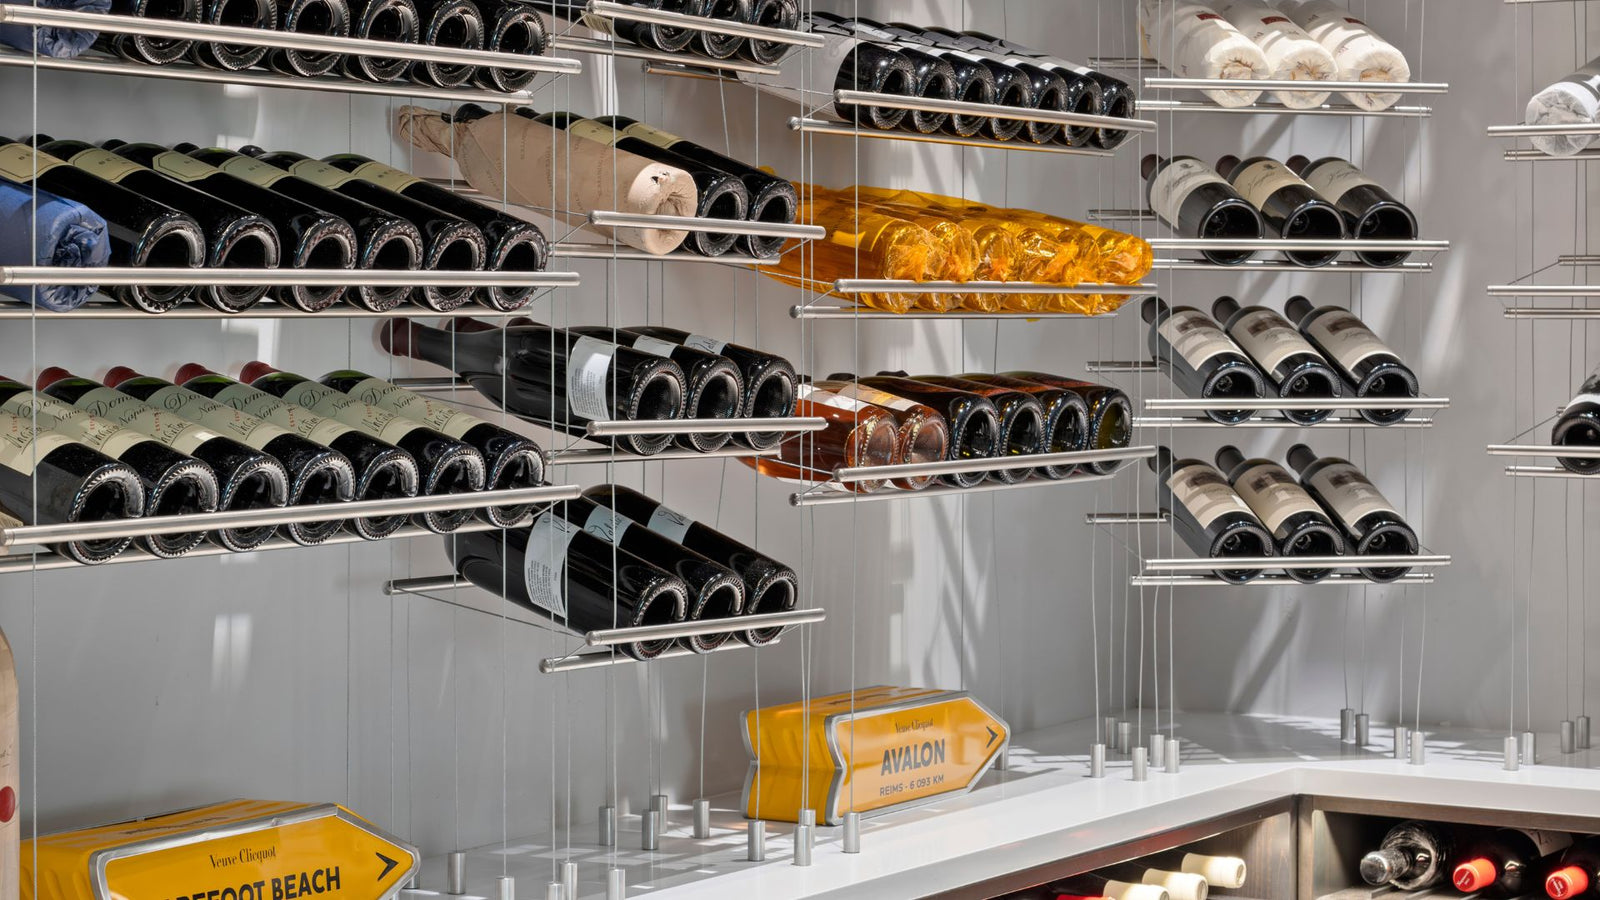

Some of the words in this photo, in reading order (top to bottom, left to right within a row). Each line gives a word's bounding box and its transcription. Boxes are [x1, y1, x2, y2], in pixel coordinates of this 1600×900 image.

[881, 739, 945, 776] AVALON
[879, 783, 904, 796] REIMS
[909, 780, 915, 789] 6
[916, 777, 931, 788] 093
[932, 774, 944, 784] KM
[209, 854, 238, 869] Veuve
[239, 846, 277, 863] Clicquot
[271, 866, 341, 900] BEACH
